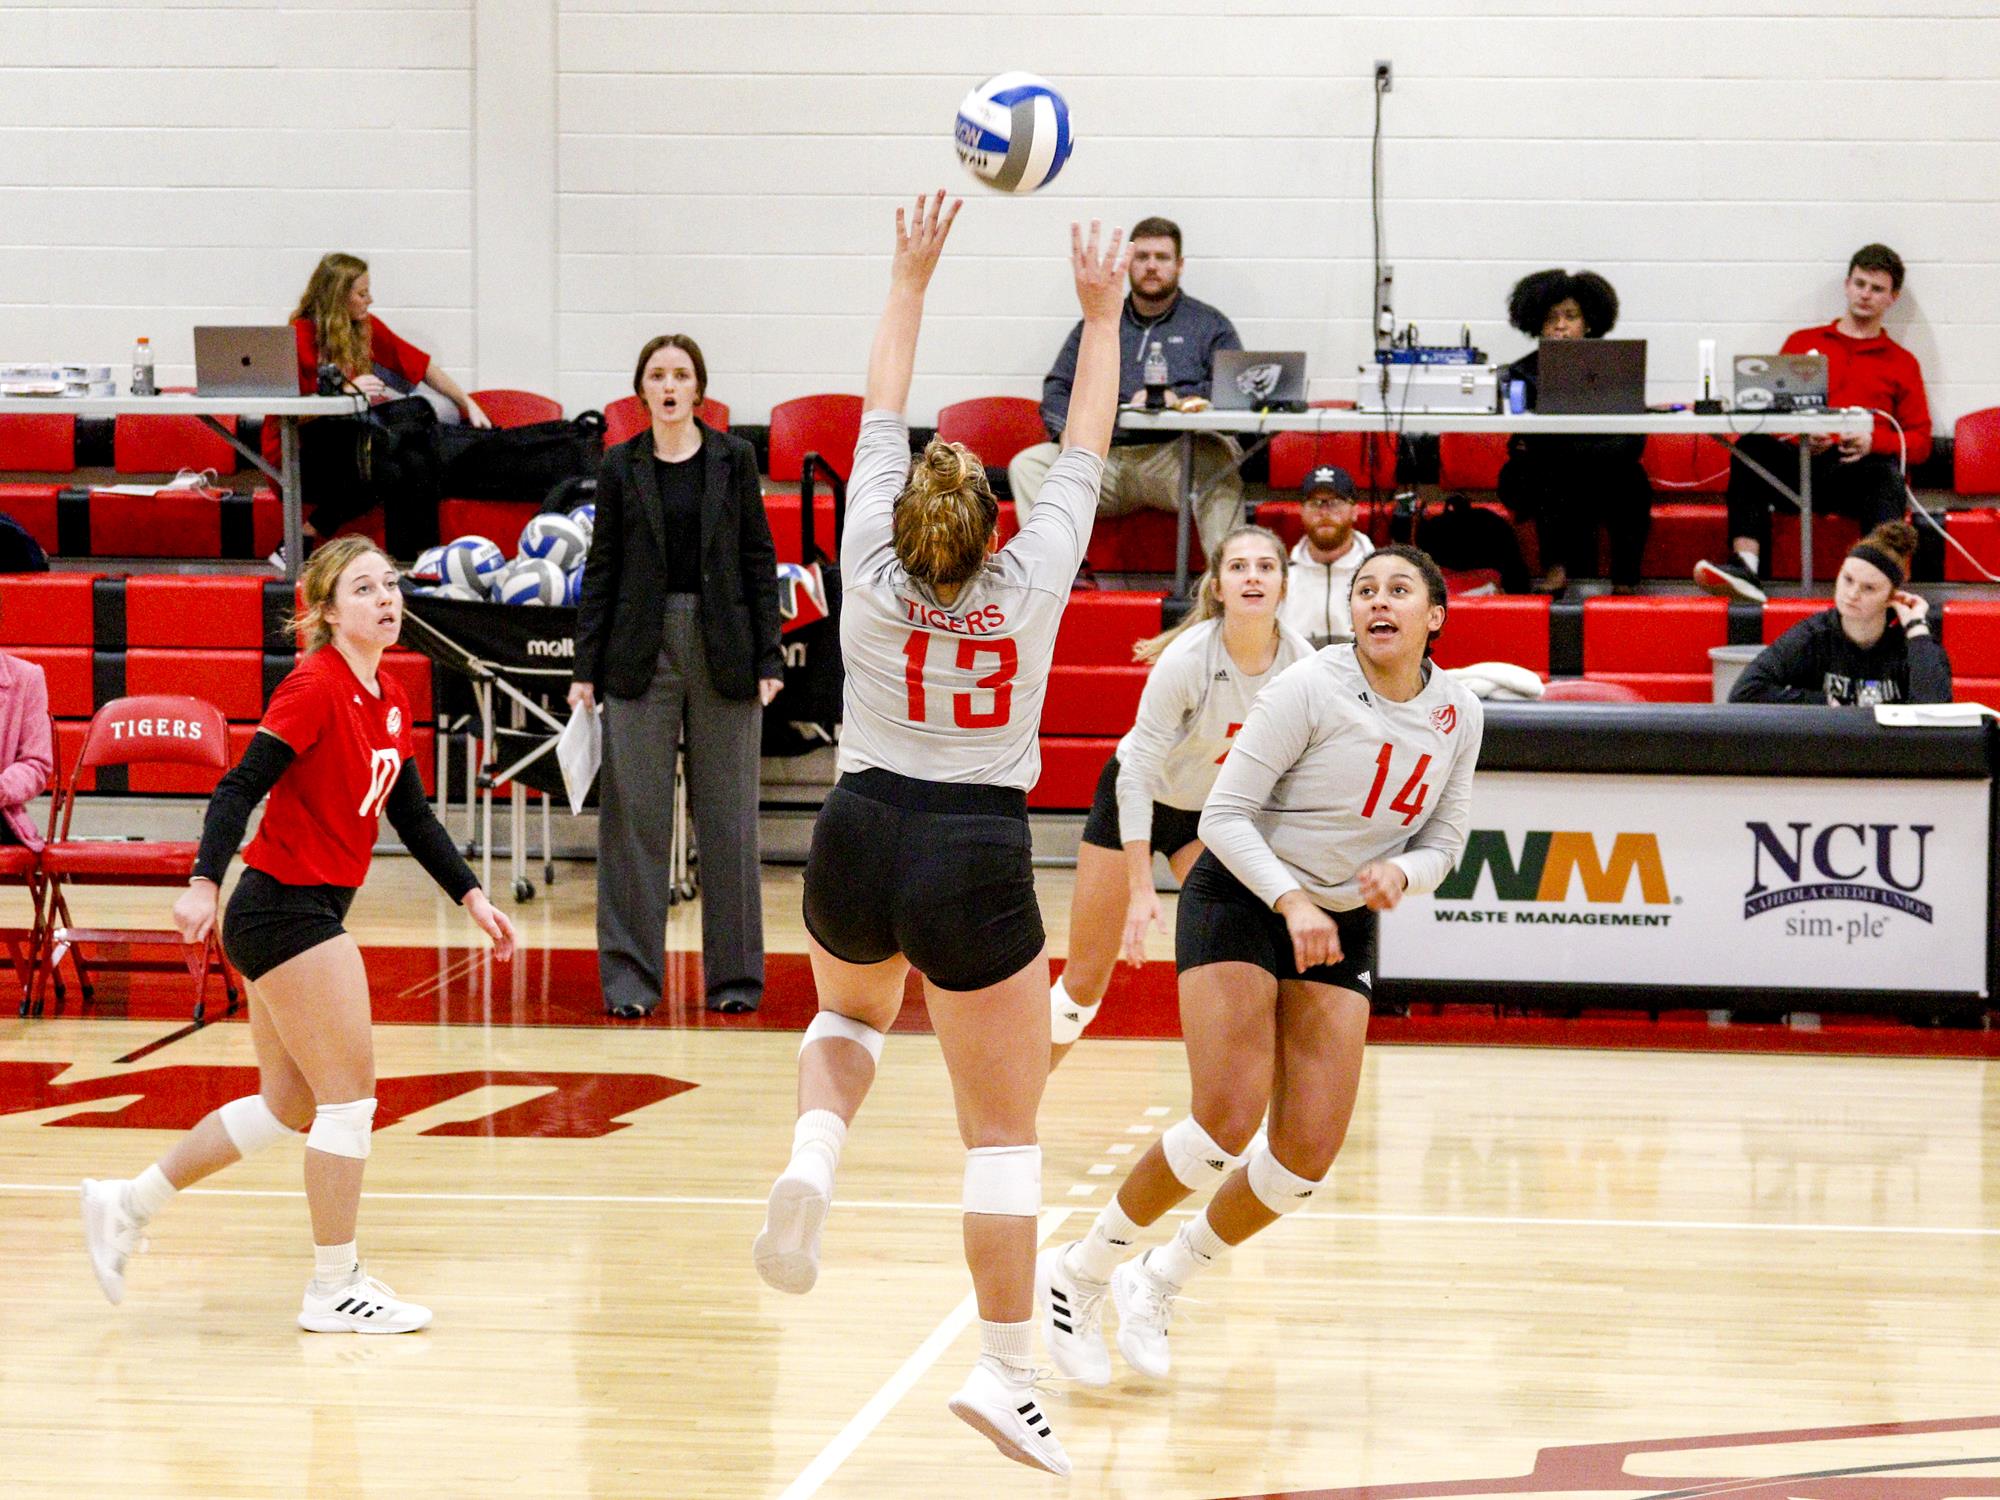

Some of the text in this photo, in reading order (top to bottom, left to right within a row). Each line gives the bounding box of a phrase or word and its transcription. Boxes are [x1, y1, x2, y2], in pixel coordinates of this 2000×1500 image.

[904, 597, 1005, 635] TIGERS
[527, 638, 575, 658] molt
[902, 630, 1018, 729] 13
[110, 718, 202, 740] TIGERS
[1361, 742, 1433, 826] 14
[1434, 829, 1671, 904] WM
[1745, 822, 1935, 898] NCU
[1434, 910, 1672, 927] WASTE MANAGEMENT
[1821, 885, 1876, 902] CREDIT
[1881, 890, 1933, 922] UNION
